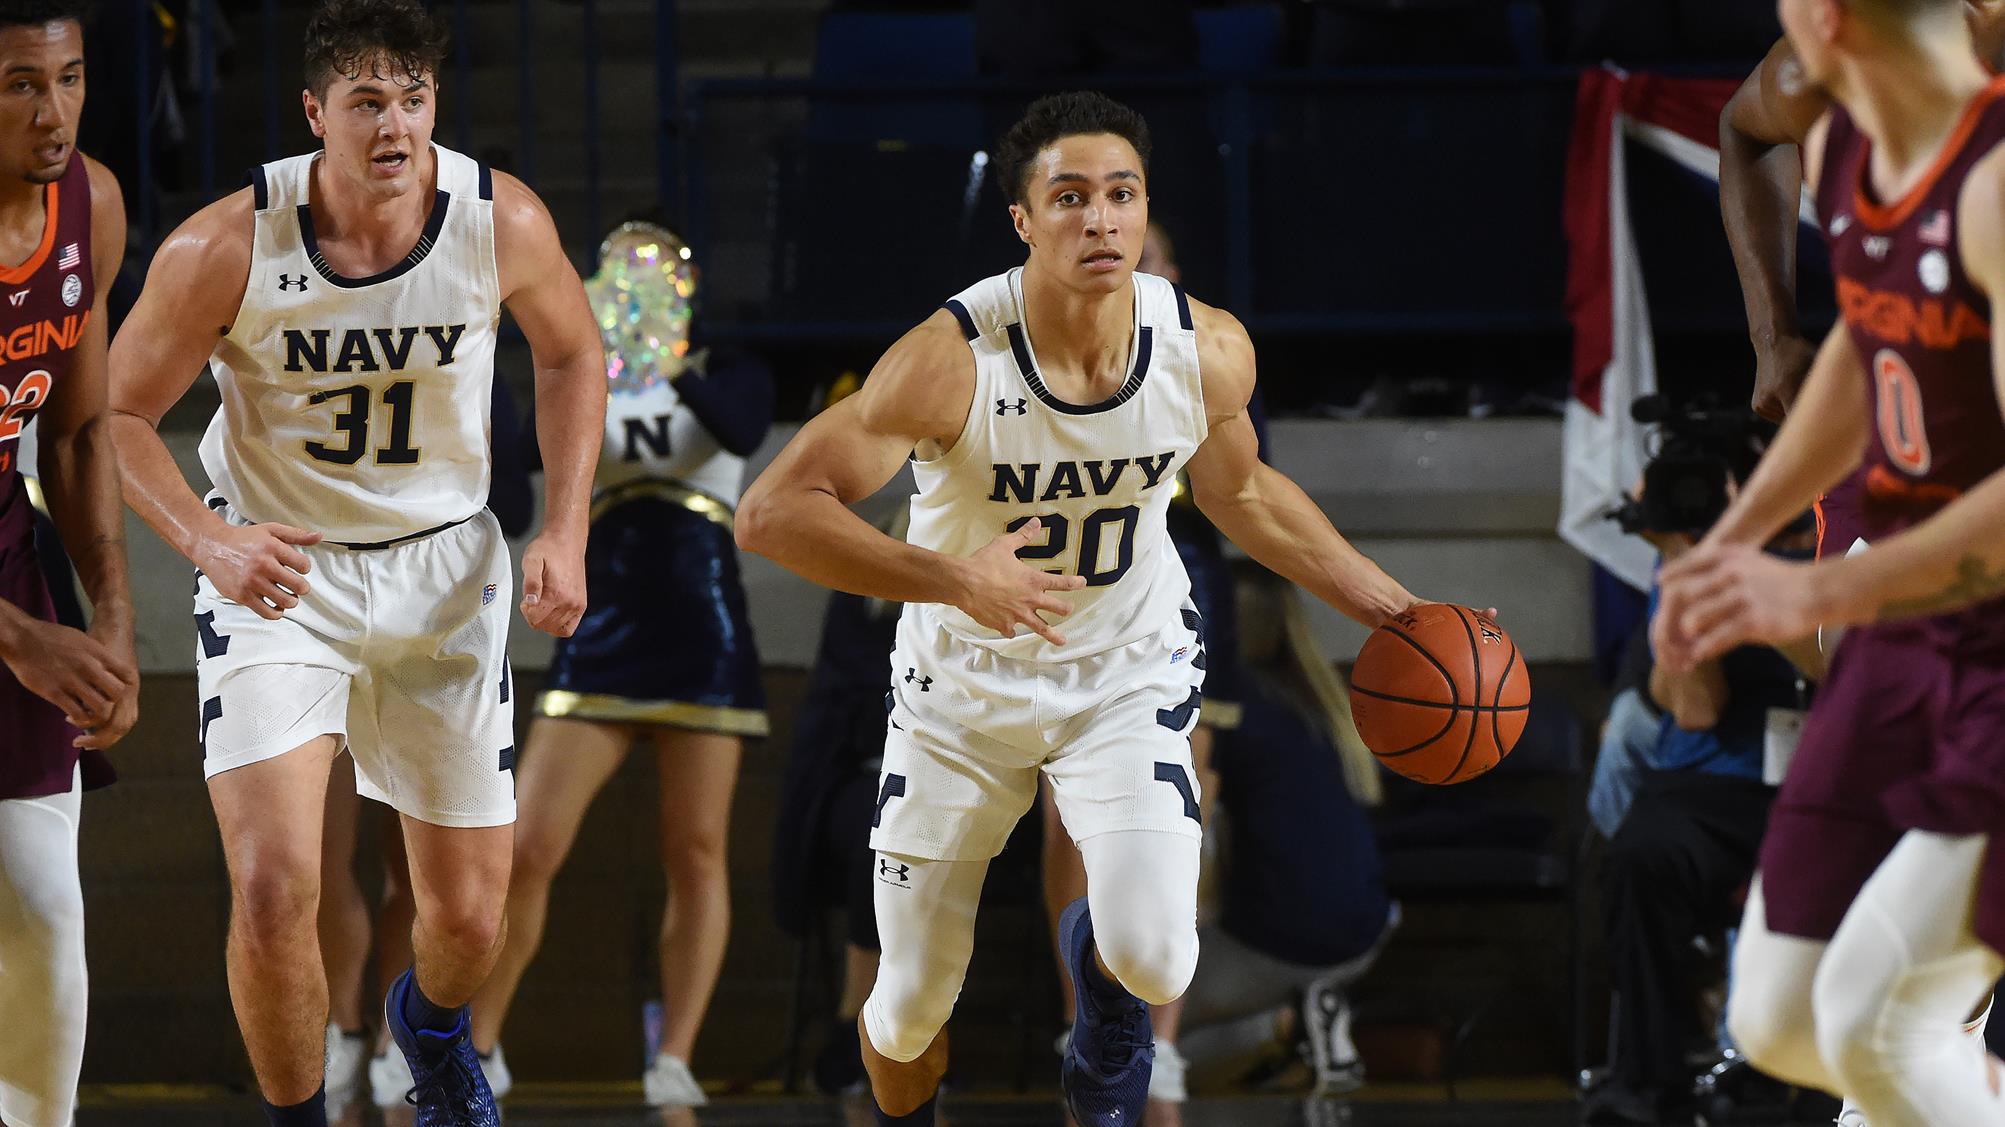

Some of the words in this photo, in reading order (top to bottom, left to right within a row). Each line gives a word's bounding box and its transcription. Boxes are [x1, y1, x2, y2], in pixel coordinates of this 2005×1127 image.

[9, 288, 30, 306] VT
[283, 323, 467, 372] NAVY
[0, 369, 52, 442] 2
[303, 379, 421, 466] 31
[1873, 349, 1932, 476] 0
[621, 413, 672, 462] N
[988, 450, 1176, 504] NAVY
[1003, 503, 1141, 588] 20
